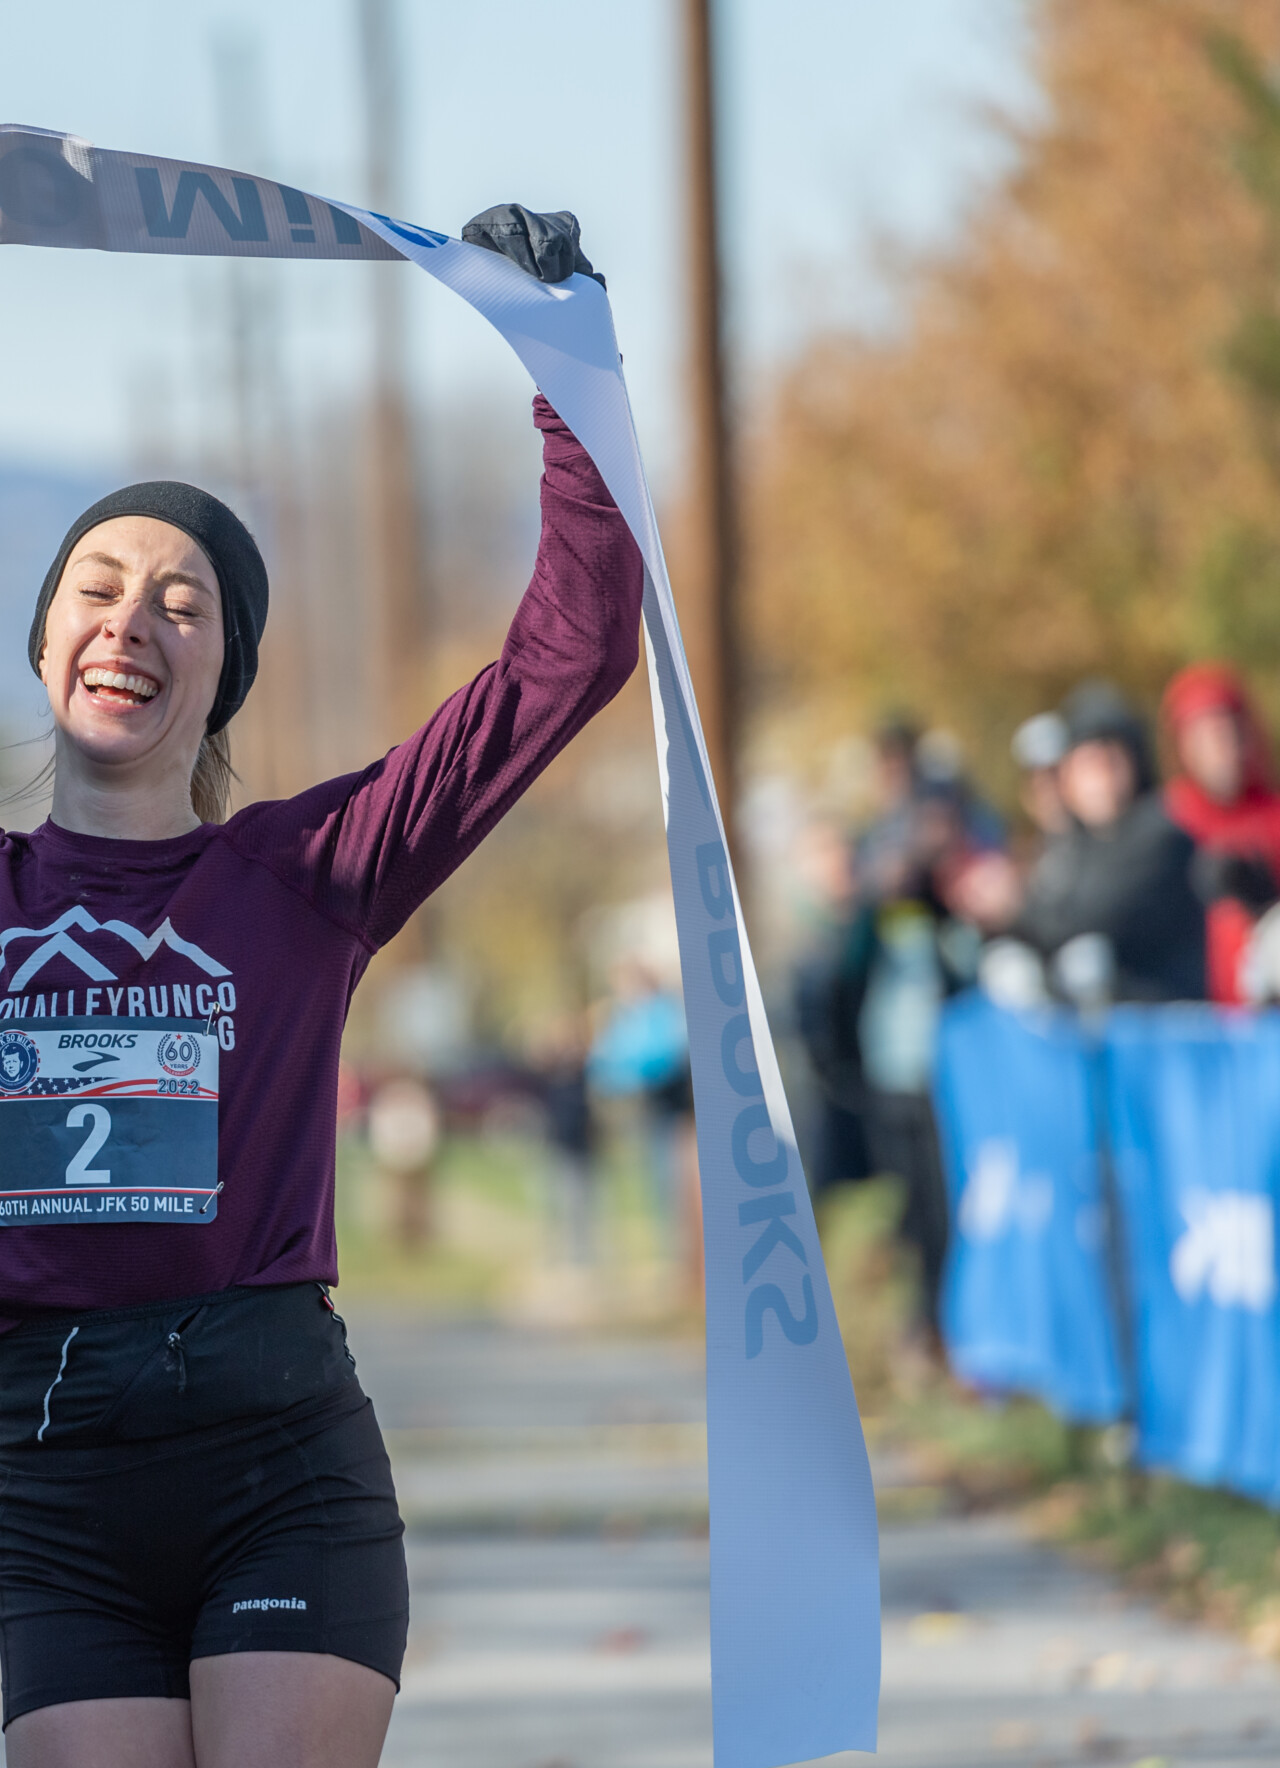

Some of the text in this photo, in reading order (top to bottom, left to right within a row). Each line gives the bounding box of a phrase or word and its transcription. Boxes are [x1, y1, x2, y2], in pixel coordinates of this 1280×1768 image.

[6, 1034, 16, 1042] 50
[17, 1034, 32, 1051] MILE
[58, 1033, 138, 1049] BROOKS
[165, 1041, 192, 1062] 60
[157, 1078, 200, 1094] 2022
[65, 1103, 111, 1184] 2
[31, 1197, 93, 1215] ANNUAL
[96, 1196, 127, 1213] JFK
[131, 1196, 149, 1212] 50
[154, 1197, 194, 1213] MILE
[232, 1597, 307, 1613] patagonia
